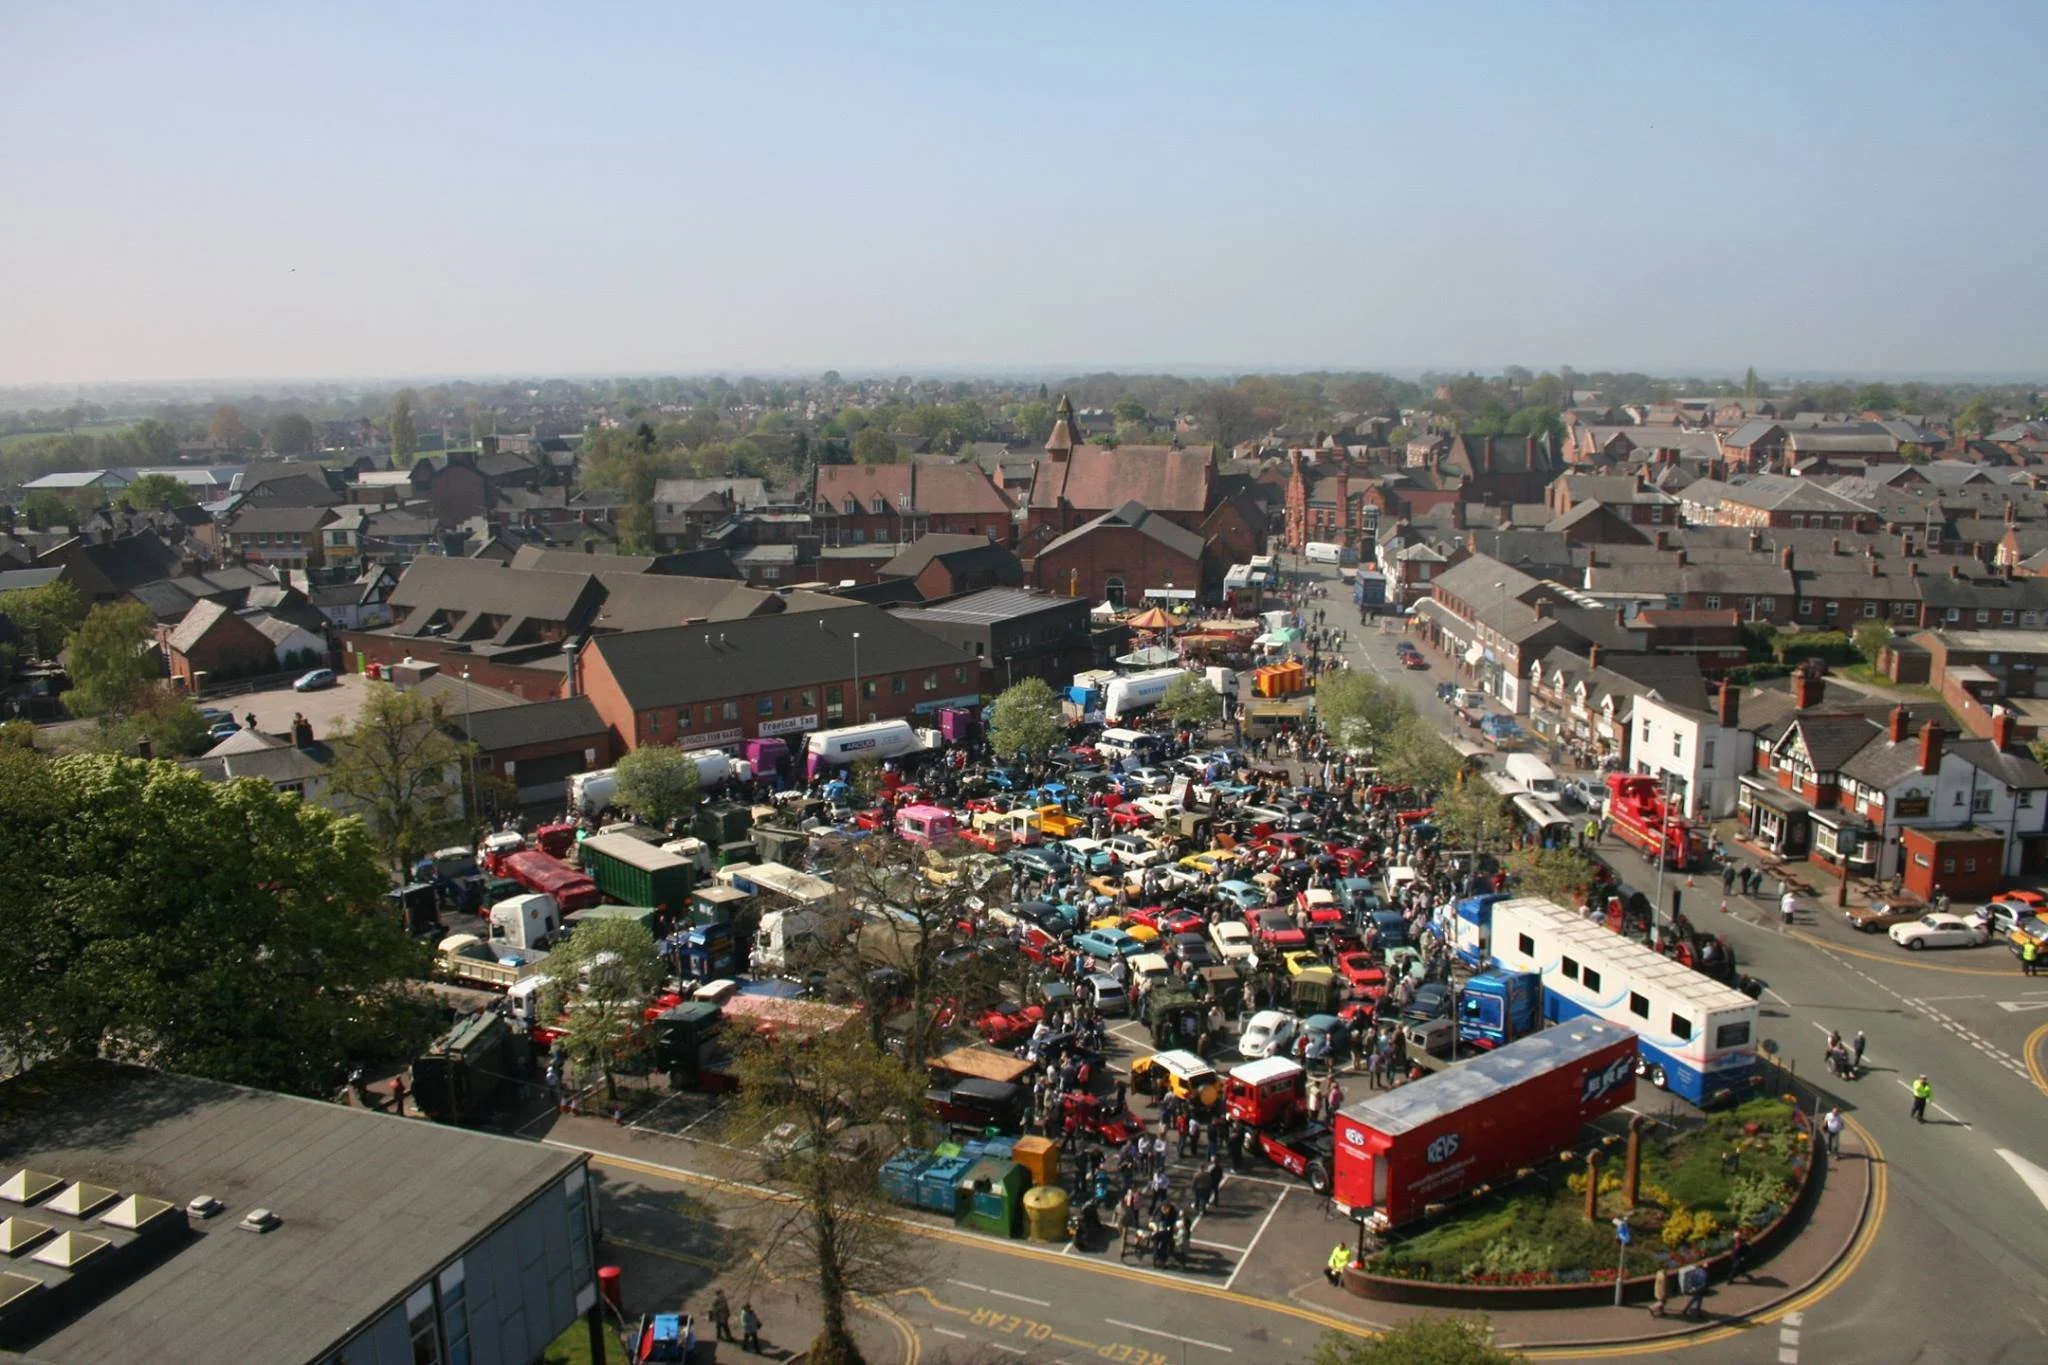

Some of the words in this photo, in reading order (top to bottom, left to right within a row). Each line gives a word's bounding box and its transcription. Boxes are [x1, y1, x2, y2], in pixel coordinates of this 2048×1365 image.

[1584, 1058, 1632, 1098] ERF
[1344, 1128, 1365, 1146] REVS
[1427, 1133, 1459, 1163] REVS
[969, 1307, 1052, 1340] CLEAR
[1097, 1342, 1167, 1365] KEEP
